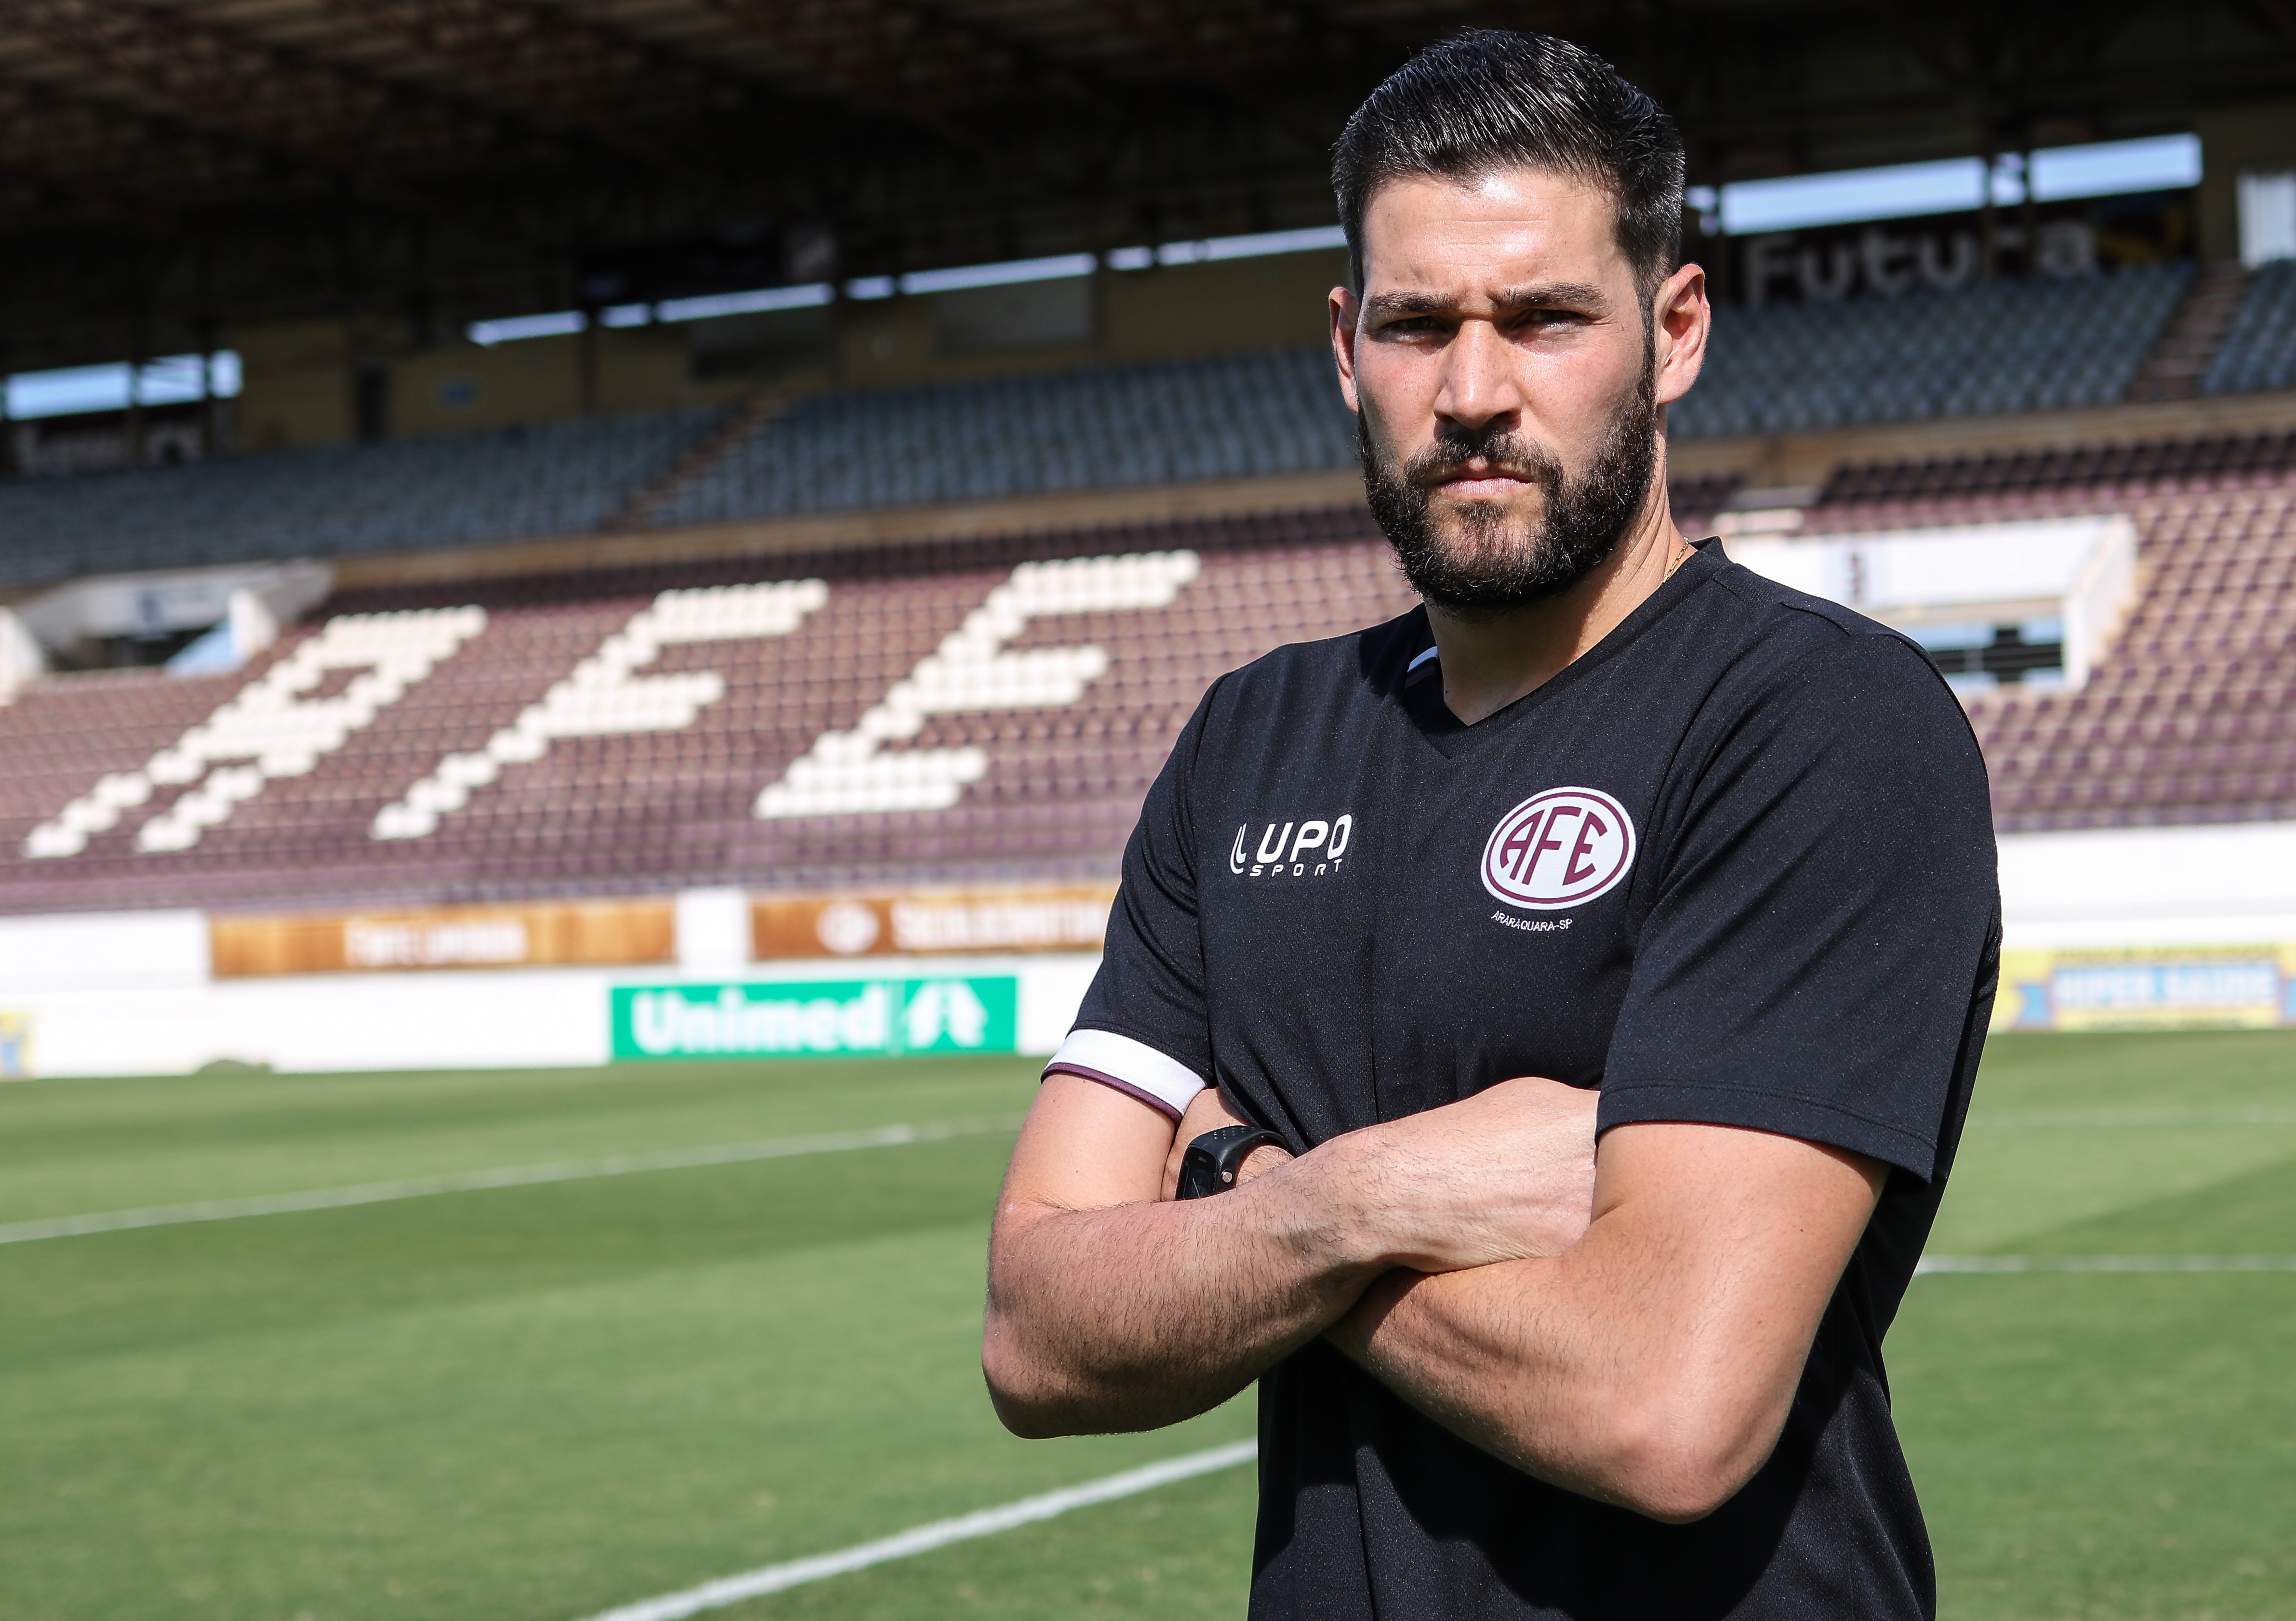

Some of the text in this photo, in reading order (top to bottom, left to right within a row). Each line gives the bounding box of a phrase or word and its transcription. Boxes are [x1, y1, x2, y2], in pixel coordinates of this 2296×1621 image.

[24, 550, 1200, 858] AFE
[1230, 814, 1352, 874] LUPO
[1249, 858, 1342, 877] SPORT
[1500, 805, 1608, 886] AFE
[1490, 910, 1572, 931] ARARAQUARA-SP
[630, 981, 889, 1054] Unimed
